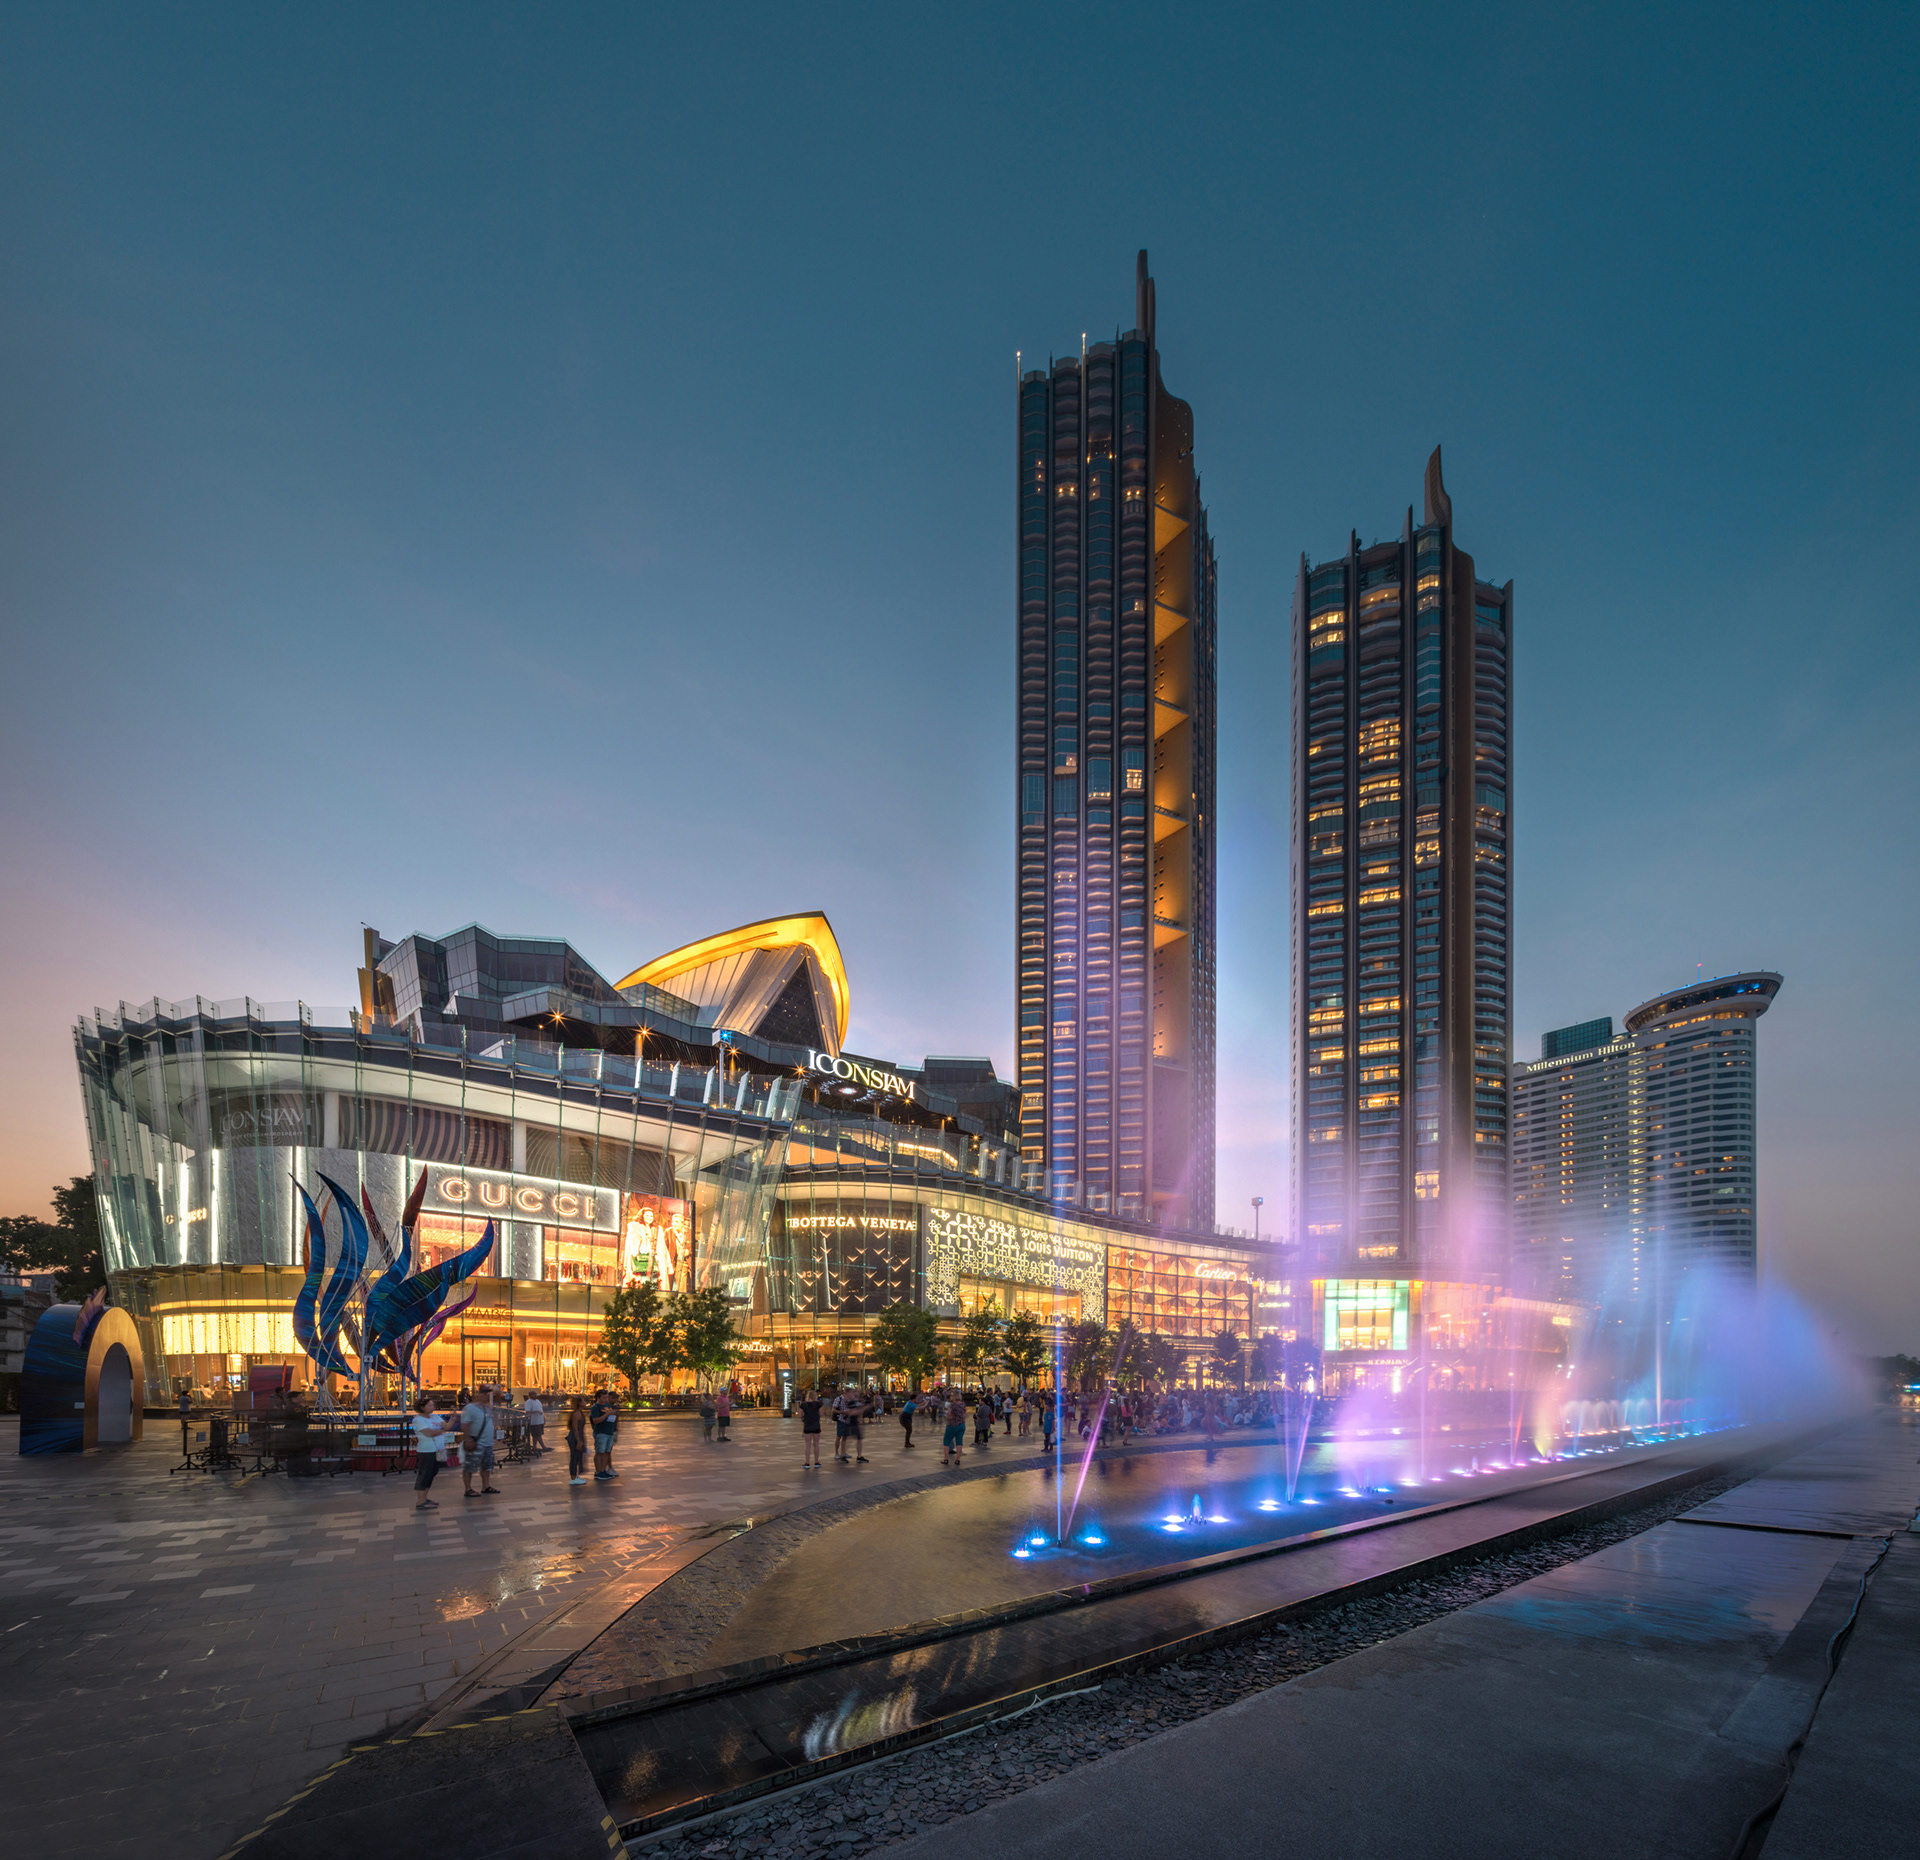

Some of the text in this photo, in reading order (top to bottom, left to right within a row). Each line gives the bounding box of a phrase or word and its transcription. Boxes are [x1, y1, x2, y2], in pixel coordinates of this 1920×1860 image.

[1526, 1041, 1636, 1073] Millennium Hilton
[808, 1049, 916, 1100] ICONSIAM
[439, 1177, 595, 1219] GUCCI
[791, 1216, 914, 1231] BOTTEGA VENETA
[1024, 1239, 1051, 1255] LOUIS
[1053, 1246, 1094, 1263] VUITTON
[1194, 1262, 1237, 1281] Cartier
